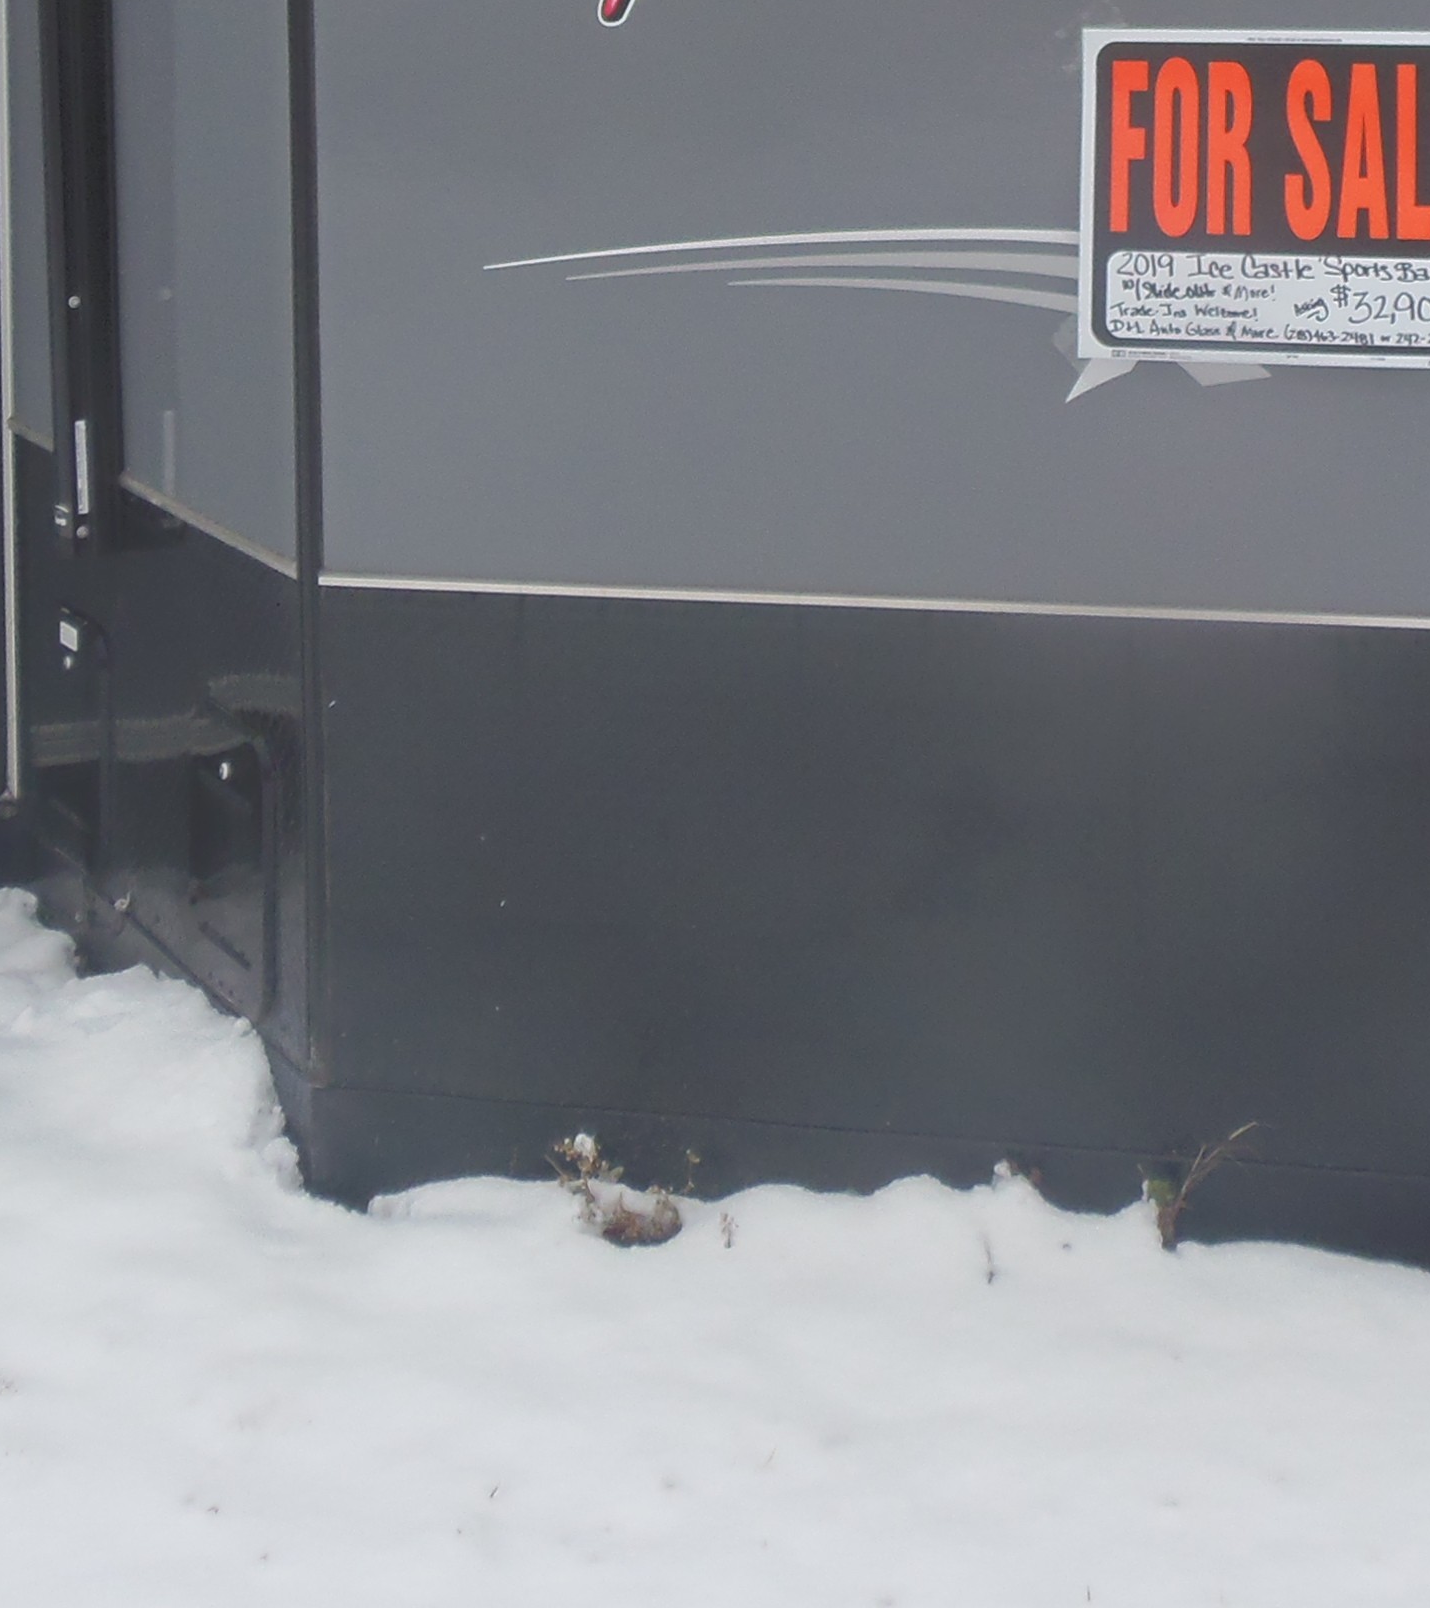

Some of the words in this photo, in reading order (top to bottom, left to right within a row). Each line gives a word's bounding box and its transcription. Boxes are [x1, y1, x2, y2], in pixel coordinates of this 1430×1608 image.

[1109, 57, 1254, 238] FOR
[1116, 253, 1174, 277] 2019
[1186, 254, 1234, 279] Ice
[1241, 253, 1315, 280] Castle
